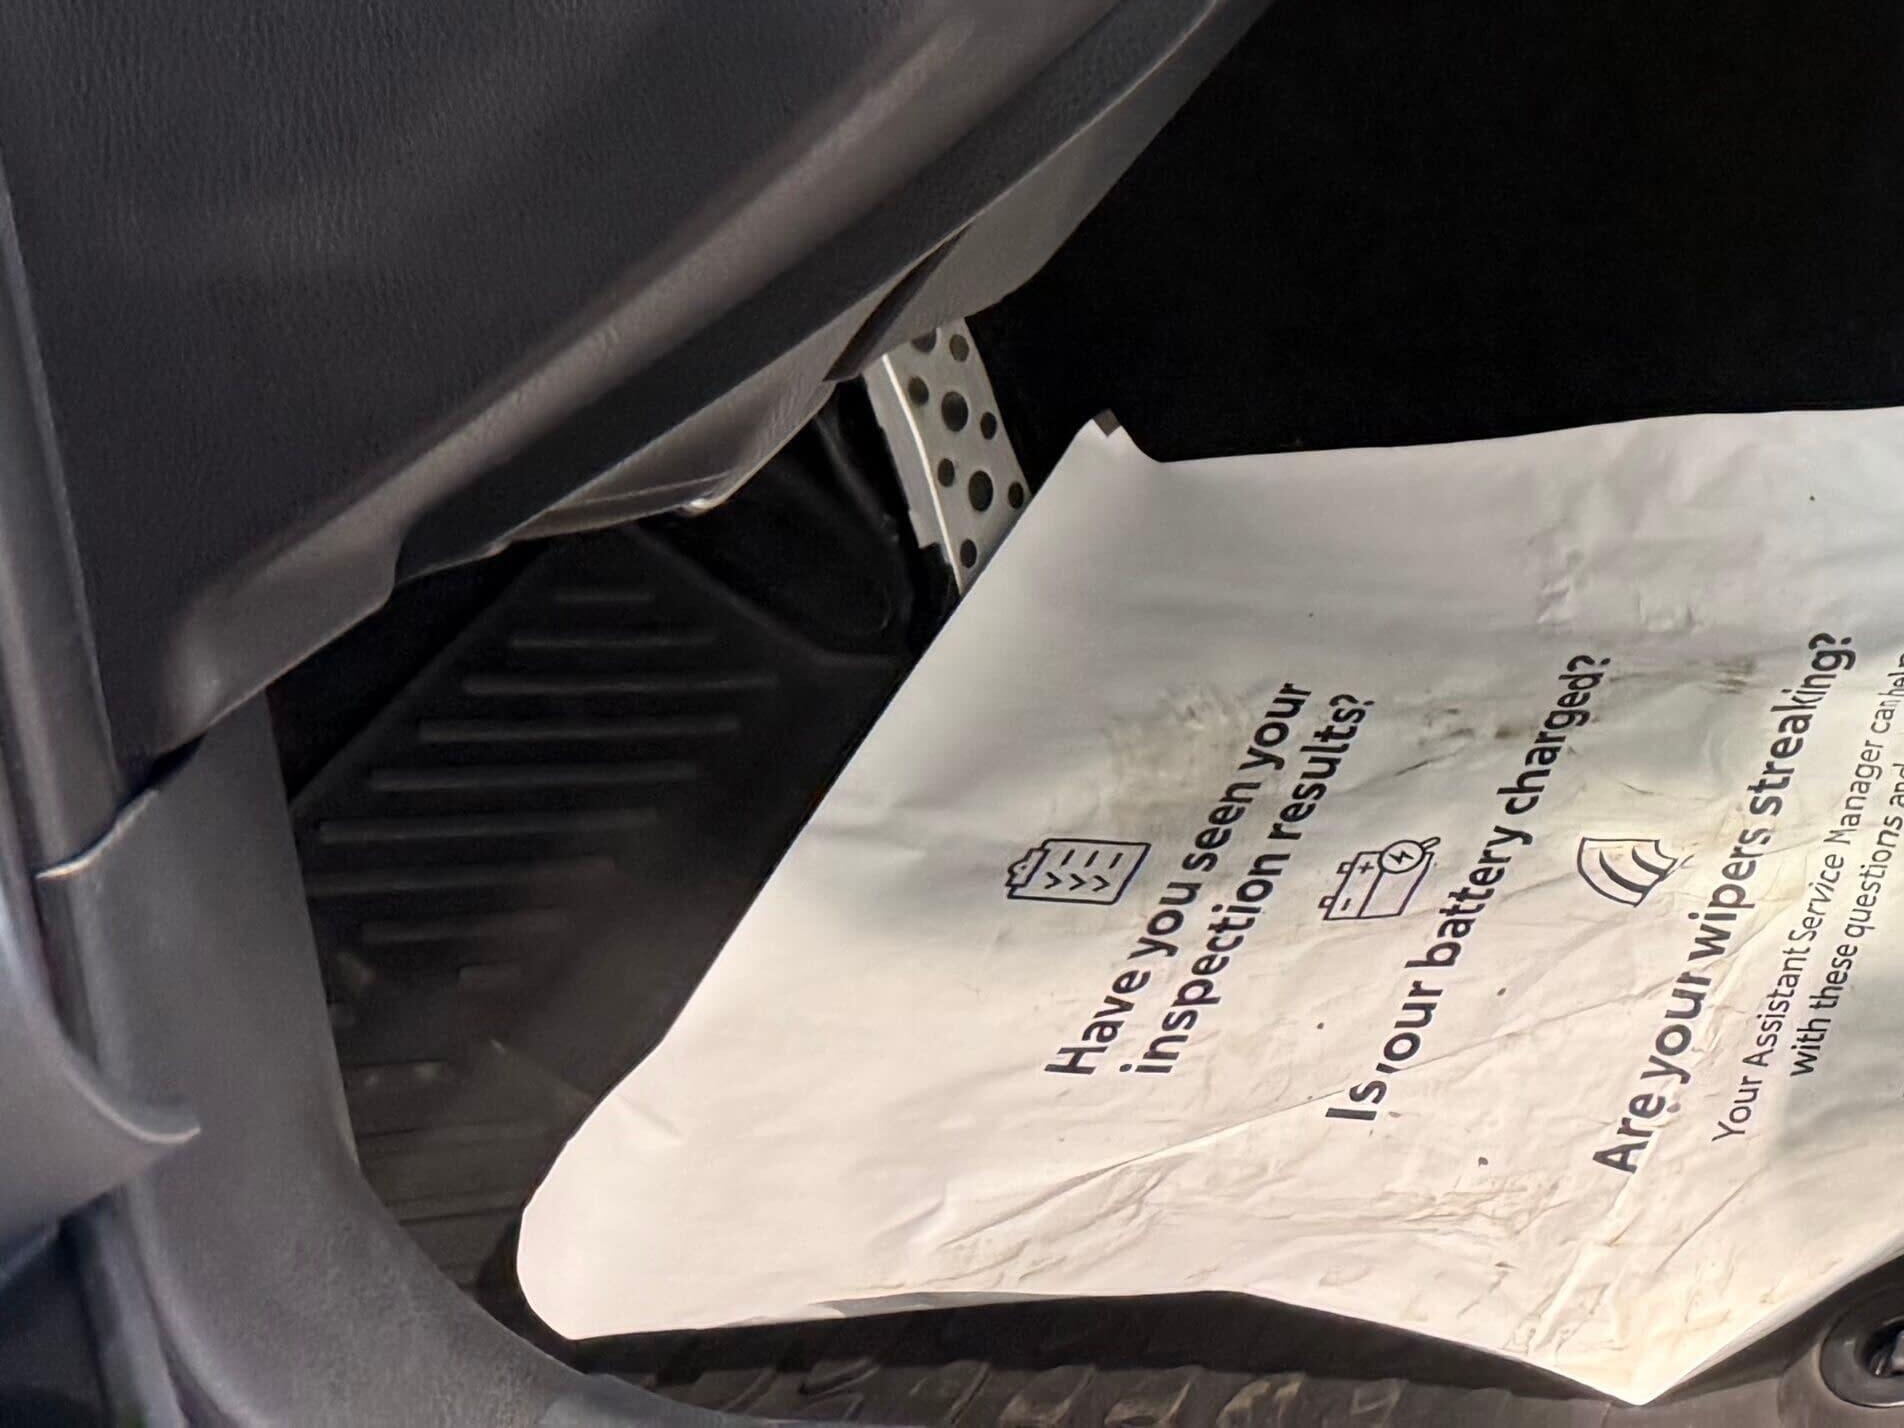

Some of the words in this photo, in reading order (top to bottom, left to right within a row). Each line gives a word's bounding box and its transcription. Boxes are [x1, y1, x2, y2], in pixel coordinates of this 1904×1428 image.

[1498, 655, 1611, 815] charged?
[1044, 970, 1150, 1075] Have
[1129, 882, 1202, 958] you
[1182, 782, 1261, 872] seen
[1239, 682, 1311, 770] your
[1119, 853, 1290, 1073] inspection
[1268, 694, 1375, 840] results?
[1404, 825, 1533, 968] battery
[1592, 1093, 1666, 1174] Are
[1641, 971, 1711, 1083] your
[1688, 828, 1774, 961] wipers
[1747, 633, 1856, 816] streaking?
[1712, 1075, 1762, 1141] Your
[1742, 947, 1810, 1067] Assistant
[1788, 854, 1844, 941] Service
[1823, 740, 1883, 844] Manager
[1844, 816, 1903, 938] questions
[1376, 980, 1443, 1073] our
[1790, 1018, 1831, 1076] with
[1809, 944, 1858, 1010] these
[1325, 1080, 1387, 1121] Is
